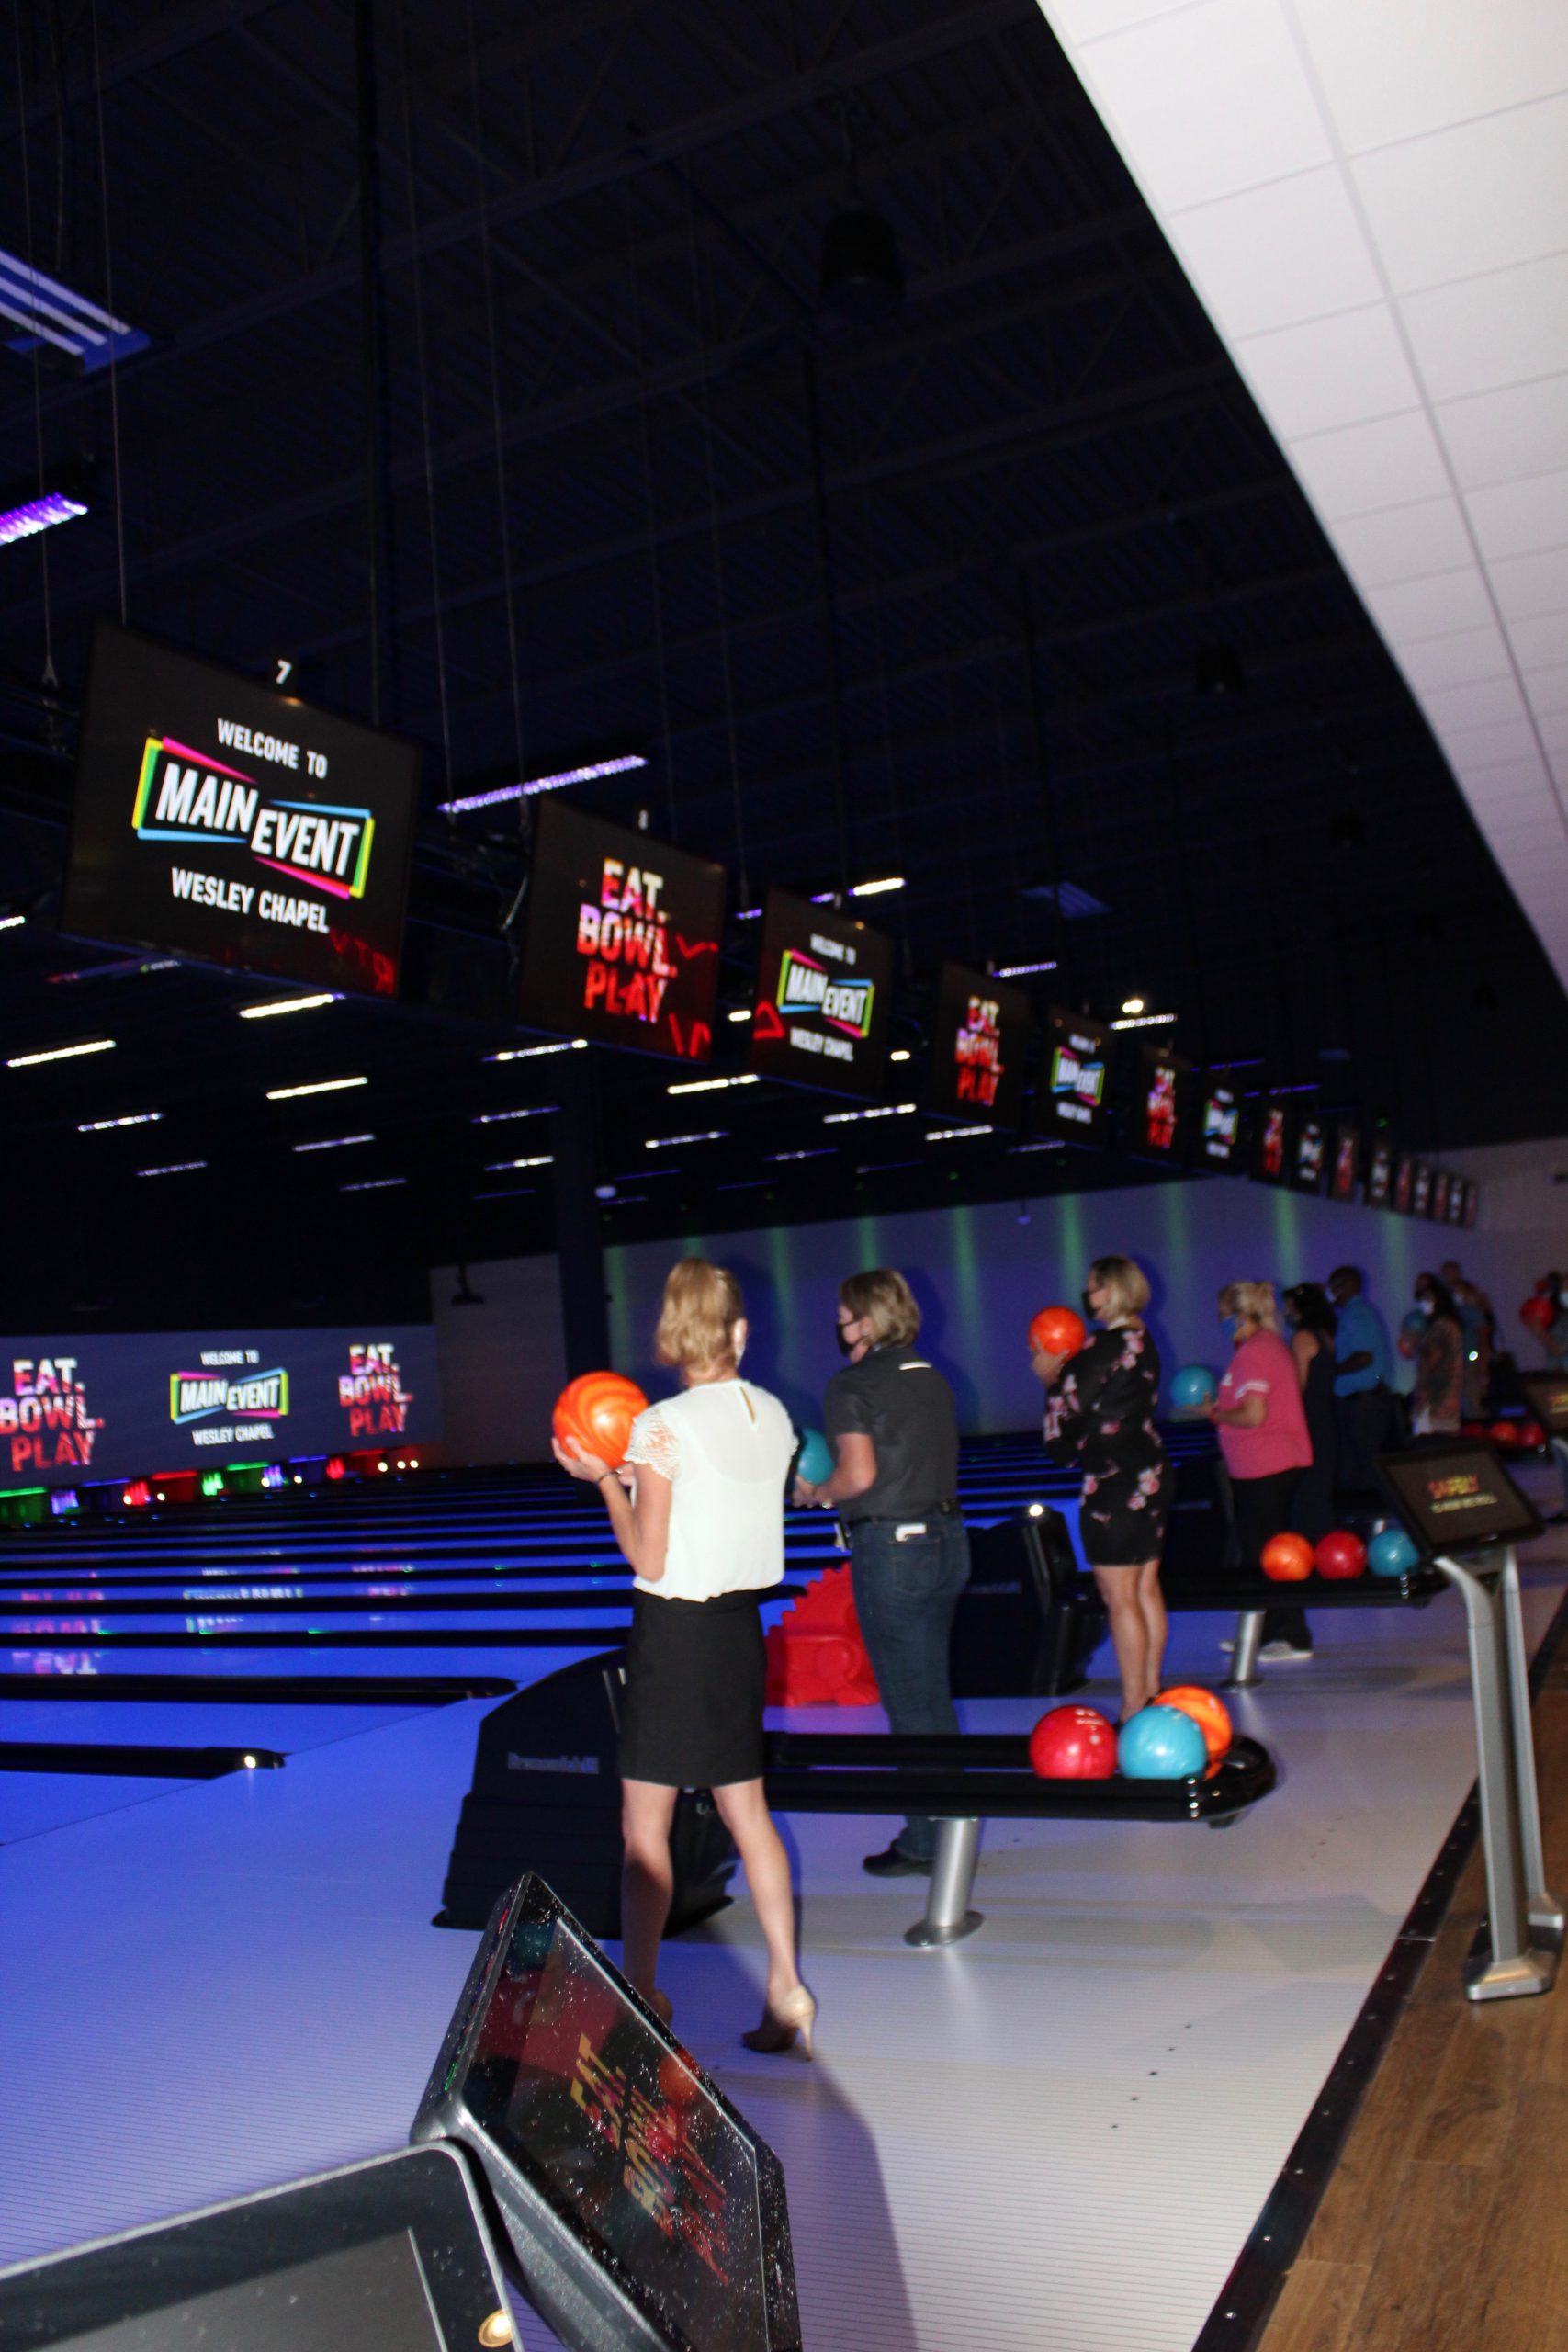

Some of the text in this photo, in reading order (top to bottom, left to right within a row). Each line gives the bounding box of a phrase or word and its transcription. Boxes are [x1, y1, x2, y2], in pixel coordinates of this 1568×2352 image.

[276, 659, 292, 684] 7
[217, 718, 328, 779] WELCOME TO
[154, 762, 361, 876] MAIN EVENT
[171, 865, 330, 934] WESLEY CHAPEL
[583, 958, 669, 1024] PLAY
[785, 963, 829, 1004] MAIN
[821, 985, 868, 1025] EVENT
[200, 1349, 260, 1366] WELCOME TO
[180, 1377, 281, 1414] MAIN EVENT
[192, 1422, 275, 1446] WESLEY CHAPEL
[349, 1403, 407, 1438] PLAY
[10, 1430, 96, 1473] PLAY
